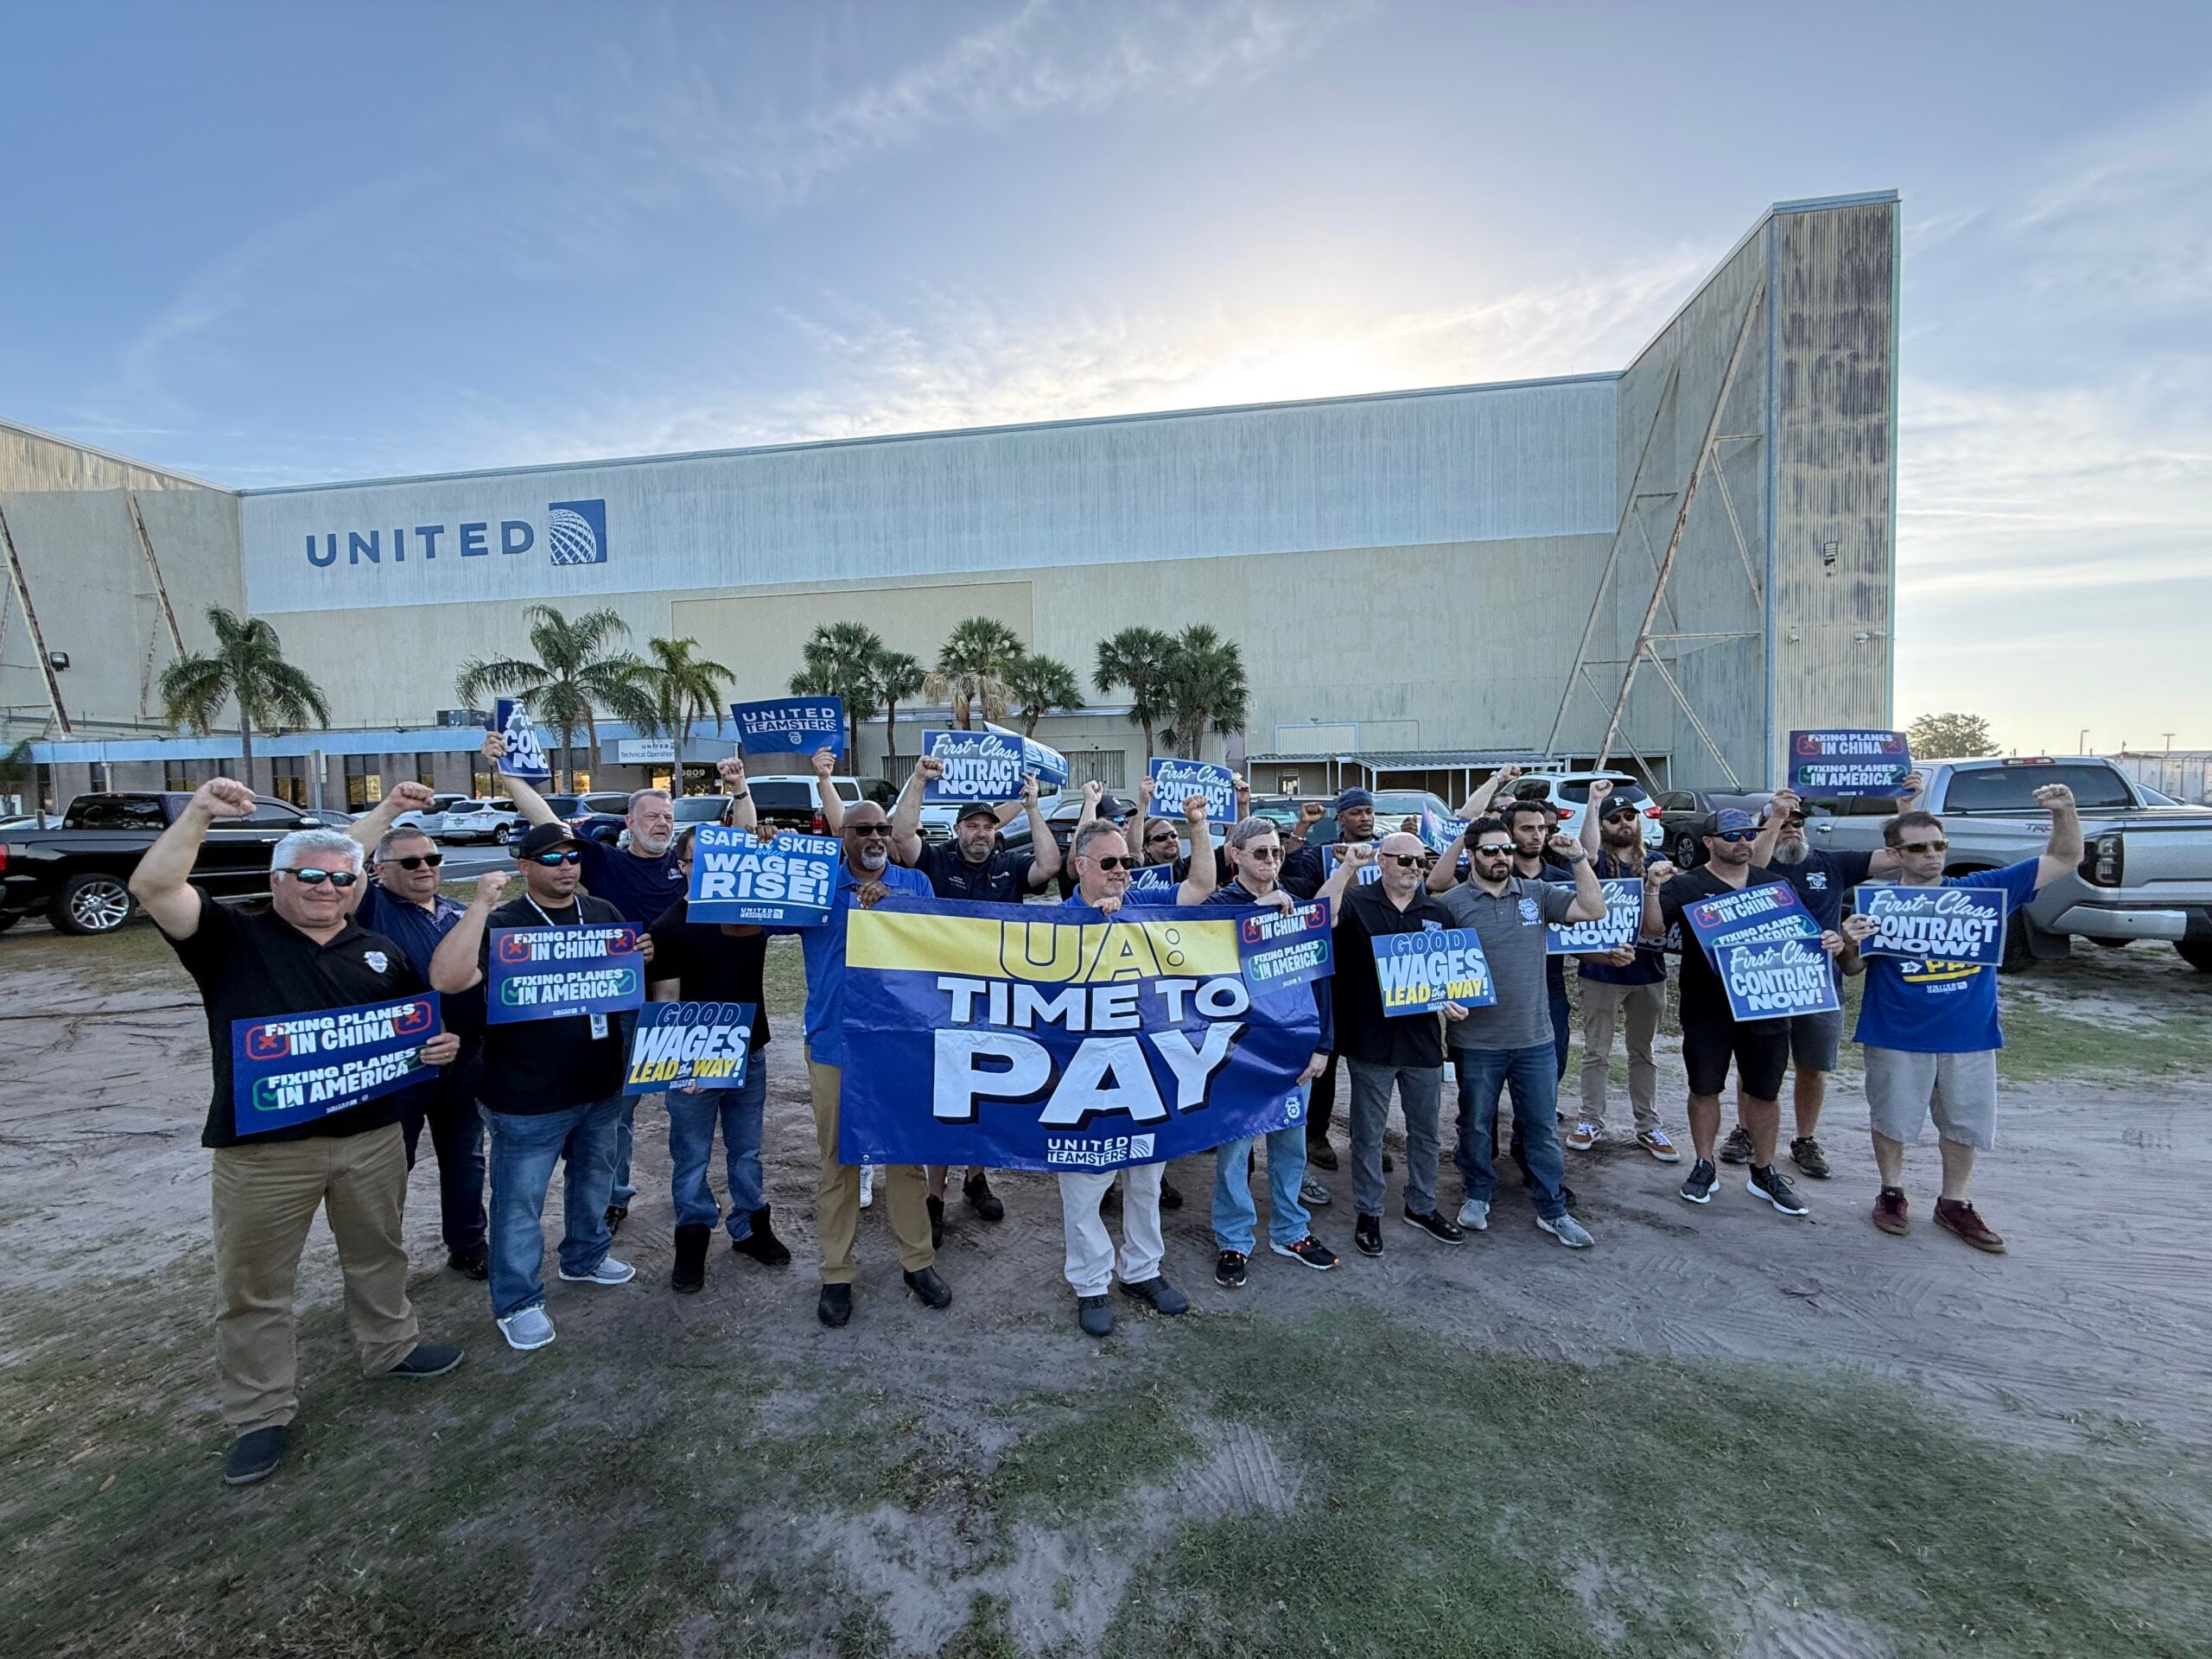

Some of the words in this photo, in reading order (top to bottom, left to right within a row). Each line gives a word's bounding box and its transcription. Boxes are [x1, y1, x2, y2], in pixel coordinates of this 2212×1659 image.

[307, 520, 534, 567] UNITED
[742, 708, 835, 721] UNITED
[745, 719, 836, 733] TEAMSTERS
[931, 734, 1021, 760] First-Class
[1821, 742, 1836, 754] IN
[1839, 741, 1883, 754] CHINA
[942, 759, 1021, 781] ONTRACT
[1157, 761, 1231, 787] First-Class
[1810, 772, 1826, 785] IN
[1828, 772, 1891, 785] AMERICA
[938, 780, 1012, 795] NOW!
[1613, 798, 1624, 806] P
[755, 845, 787, 856] when
[779, 836, 837, 855] SKIES
[704, 854, 829, 879] WAGES
[700, 872, 829, 905] RISE!
[1701, 896, 1740, 912] FIXING
[1741, 887, 1778, 902] PLANES
[1719, 905, 1737, 923] IN
[1739, 896, 1779, 917] CHINA
[1868, 889, 1998, 918] First-Class
[1250, 912, 1279, 926] FIXING
[1262, 923, 1273, 940] IN
[1274, 916, 1306, 937] CHINA
[1719, 927, 1758, 944] FIXING
[1757, 915, 1802, 933] PLANES
[514, 931, 564, 944] FIXING
[567, 929, 623, 941] PLANES
[1391, 929, 1465, 957] GOOD
[1560, 928, 1634, 945] NOW!
[1873, 935, 1980, 957] NOW!
[531, 942, 550, 961] IN
[554, 939, 607, 959] CHINA
[1000, 920, 1184, 982] UA:
[1254, 950, 1283, 964] FIXING
[1285, 940, 1319, 957] PLANES
[1730, 940, 1824, 973] First-Class
[1259, 963, 1272, 980] IN
[1273, 950, 1318, 976] AMERICA
[1377, 948, 1485, 991] WAGES
[513, 974, 564, 987] FIXING
[567, 969, 623, 983] PLANES
[1731, 965, 1826, 996] CONTRACT
[518, 986, 537, 1005] IN
[541, 980, 620, 1003] AMERICA
[938, 976, 1141, 1031] TIME
[1154, 978, 1249, 1022] TO
[1386, 984, 1430, 1007] LEAD
[1432, 986, 1446, 997] the
[1446, 977, 1488, 999] WAY!
[1747, 988, 1823, 1010] NOW!
[265, 1017, 335, 1036] FIXING
[339, 1003, 415, 1027] PLANES
[656, 1002, 741, 1028] GOOD
[290, 1032, 316, 1055] IN
[321, 1020, 396, 1051] CHINA
[632, 1025, 751, 1065] WAGES
[268, 1066, 339, 1089] FIXING
[342, 1047, 416, 1074] PLANES
[628, 1060, 679, 1084] LEAD
[677, 1062, 692, 1075] the
[692, 1058, 744, 1077] WAY!
[933, 1021, 1247, 1125] PAY
[276, 1085, 304, 1109] IN
[309, 1059, 409, 1103] AMERICA
[1047, 1136, 1128, 1151] UNITED
[1047, 1147, 1128, 1166] TEAMSTERS
